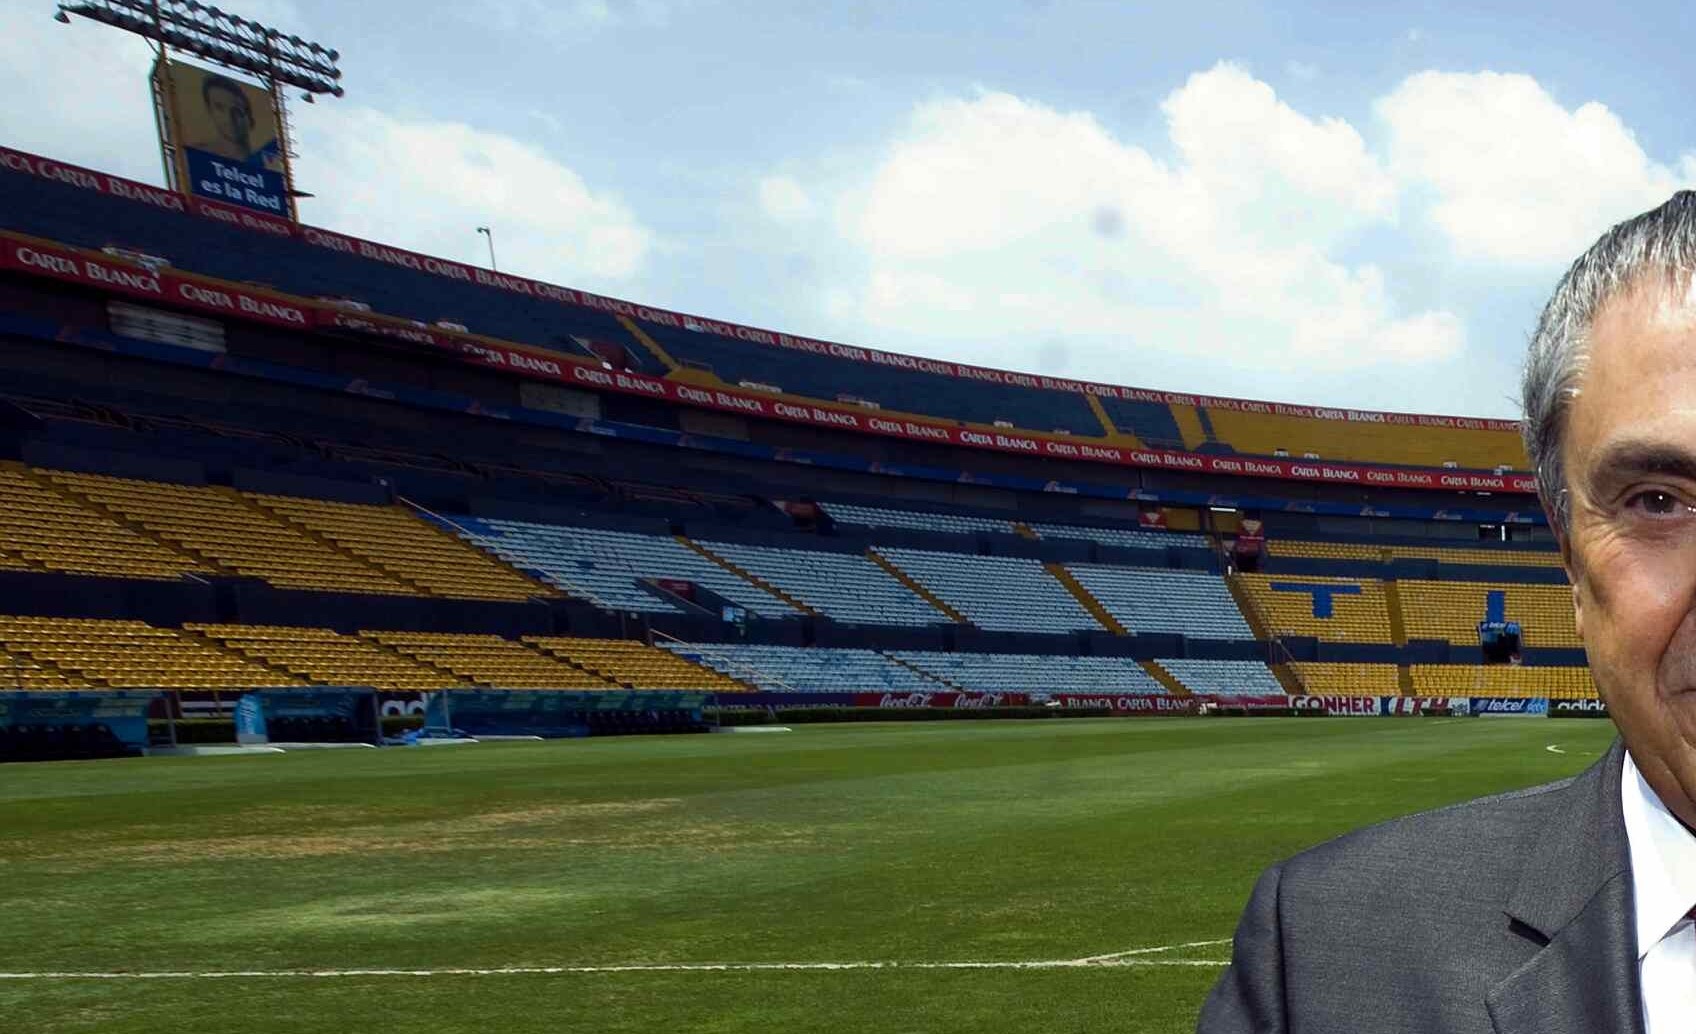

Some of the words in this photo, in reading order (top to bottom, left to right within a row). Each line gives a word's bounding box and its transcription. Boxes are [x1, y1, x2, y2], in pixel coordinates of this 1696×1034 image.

[38, 160, 102, 190] CARTA
[107, 177, 185, 212] BLANCA
[210, 160, 265, 189] Telcel
[200, 179, 223, 195] es
[224, 182, 242, 200] la
[245, 188, 281, 210] Red
[16, 247, 81, 276] CARTA
[85, 262, 161, 294] BLANCA
[178, 283, 234, 309] CARTA
[238, 295, 305, 324] BLANCA
[509, 352, 560, 375] BLANCA
[1514, 478, 1537, 490] CART
[1117, 697, 1153, 711] CARTA
[1290, 696, 1375, 714] GONHER
[1487, 699, 1525, 711] telcel
[1557, 699, 1606, 711] adid
